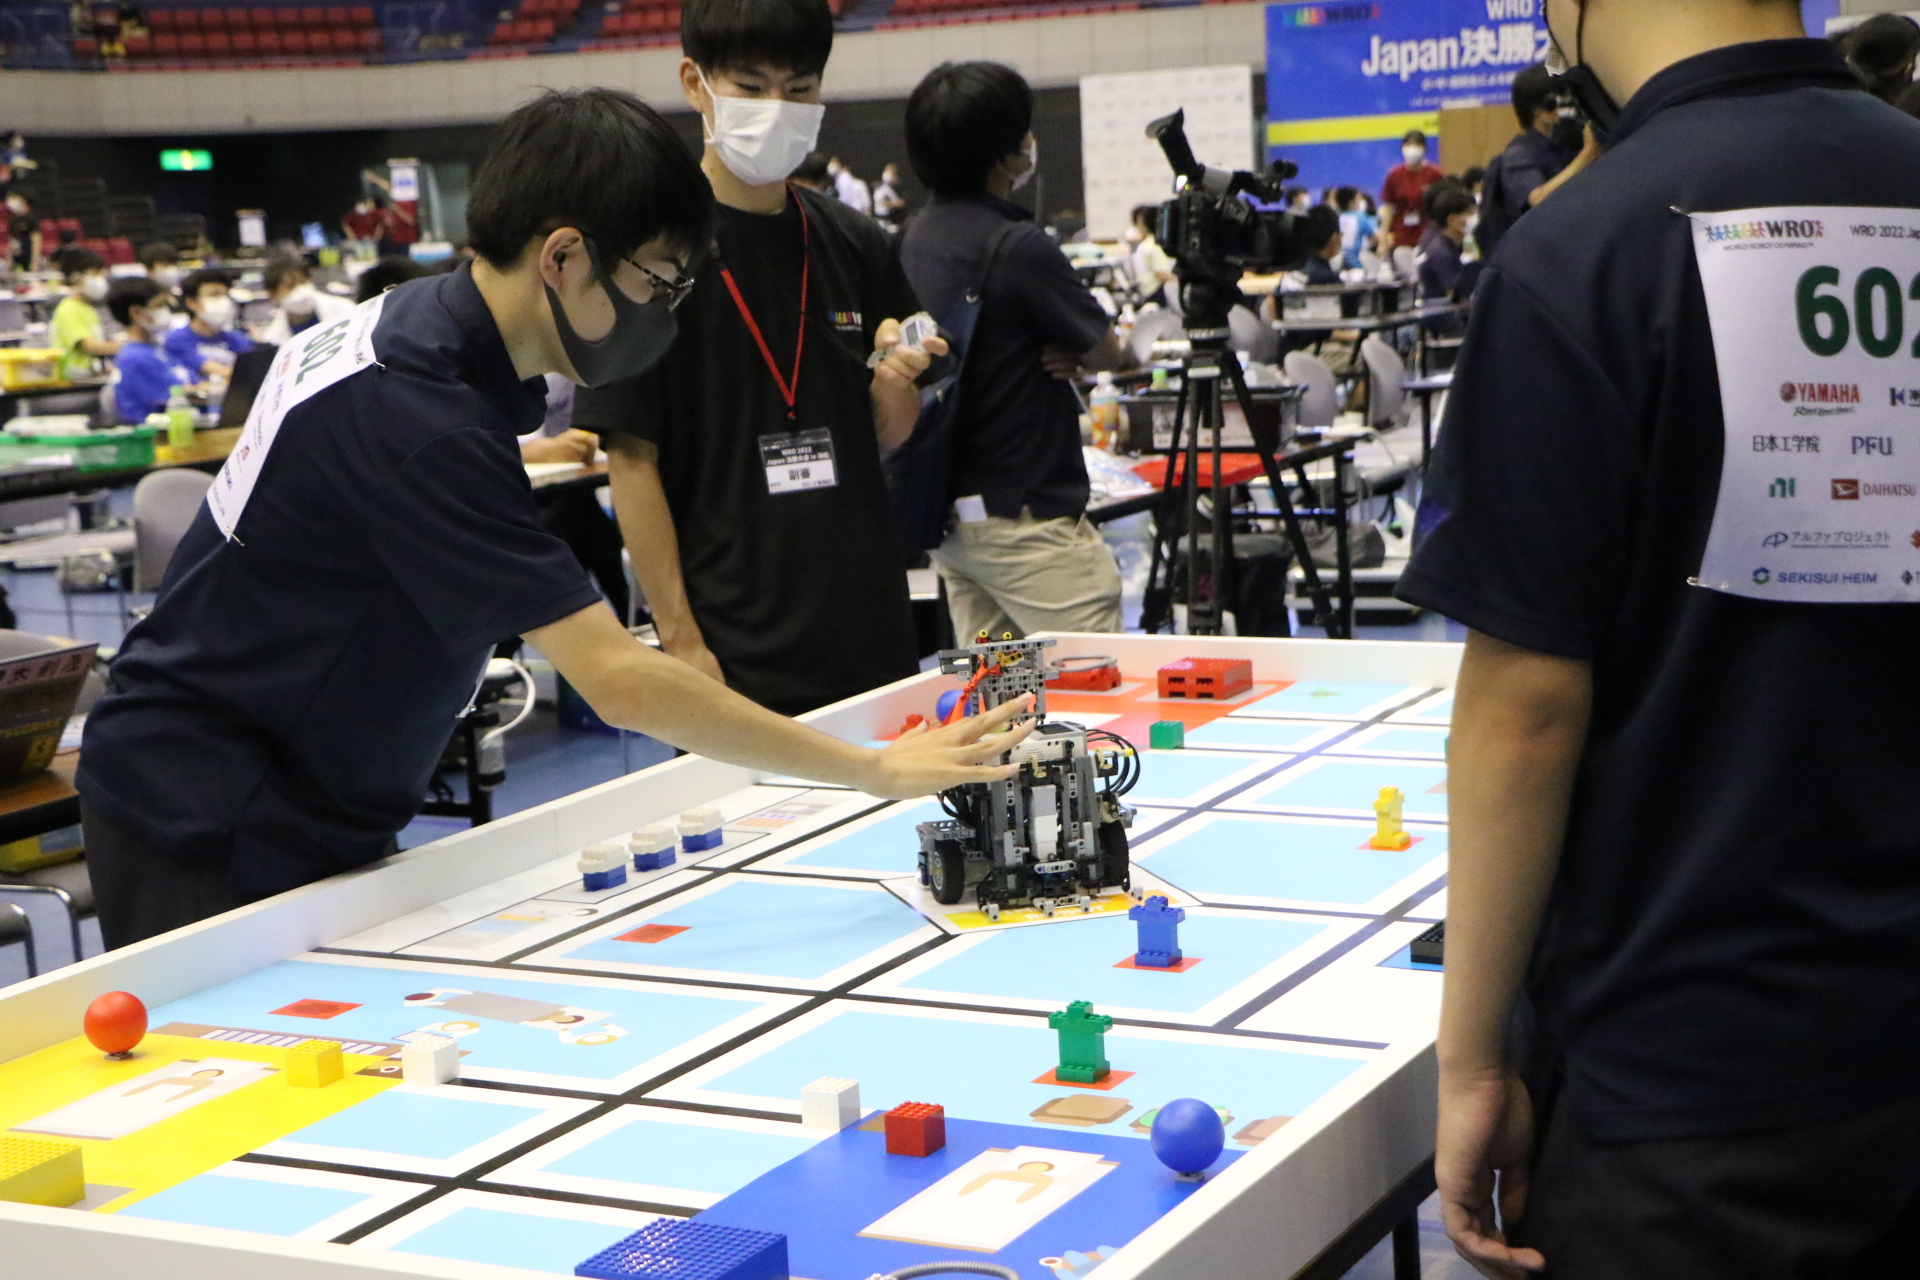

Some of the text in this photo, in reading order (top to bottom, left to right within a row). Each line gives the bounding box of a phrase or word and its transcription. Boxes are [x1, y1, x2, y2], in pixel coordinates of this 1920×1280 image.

[1765, 220, 1815, 238] WRO
[1849, 224, 1877, 237] WRO
[1879, 225, 1905, 239] 2022
[1795, 264, 1920, 360] 60
[294, 319, 351, 387] 602
[1797, 382, 1862, 403] YAMAHA
[1752, 434, 1821, 453] 日本工学院
[1850, 435, 1894, 456] PFU
[1863, 483, 1917, 497] DAIHATSU
[1791, 530, 1890, 543] アルファプロジェクト
[1778, 572, 1878, 584] SEKISUI HEIM
